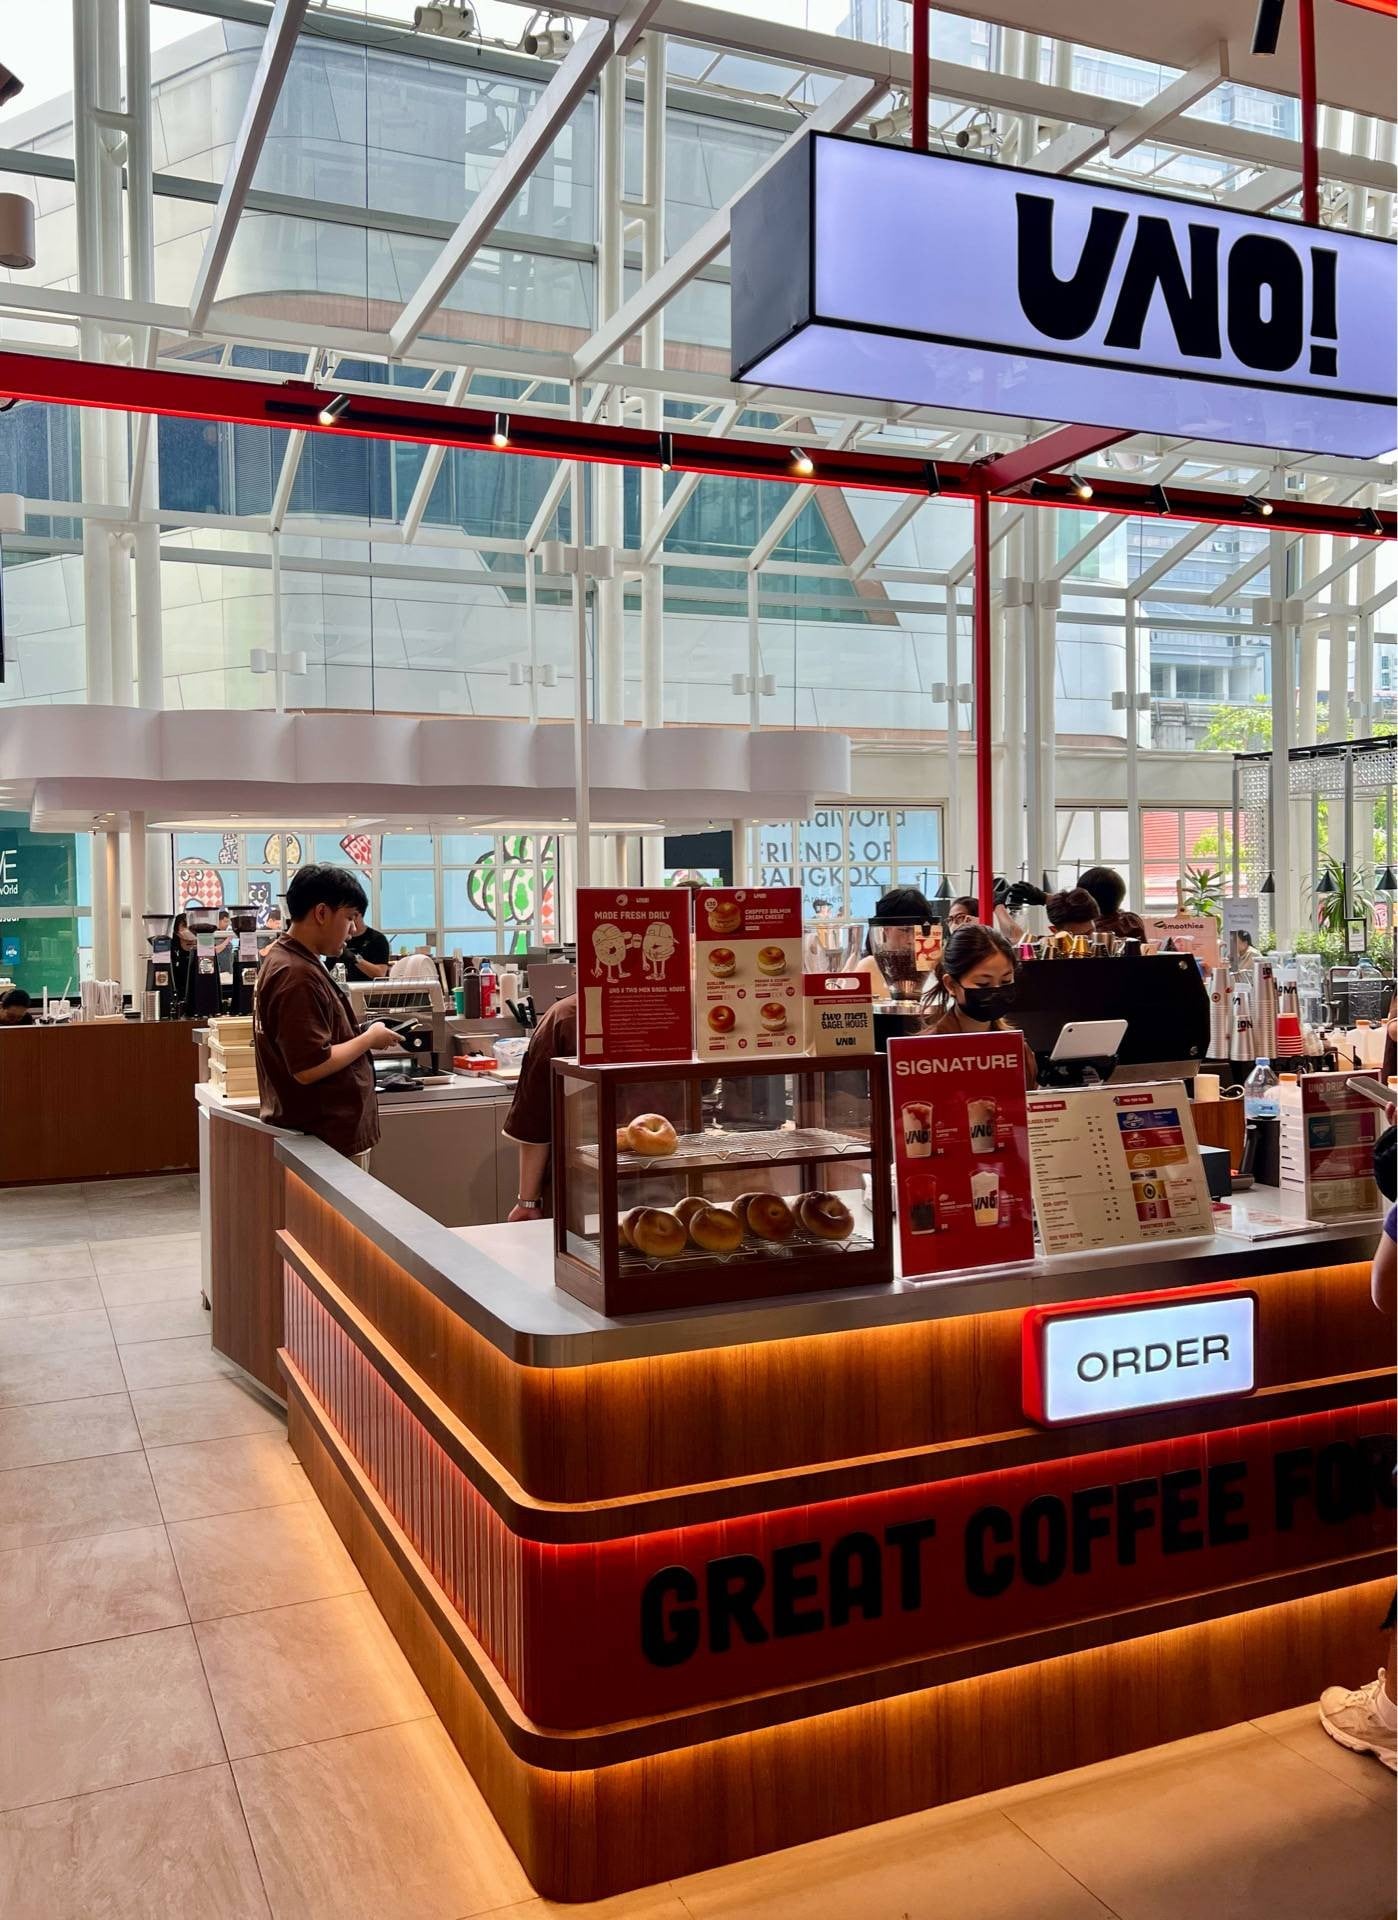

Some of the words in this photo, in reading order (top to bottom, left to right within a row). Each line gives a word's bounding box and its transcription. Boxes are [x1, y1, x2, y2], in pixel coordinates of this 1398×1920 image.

[1015, 192, 1339, 377] UNO!
[594, 911, 618, 920] MADE
[620, 911, 646, 920] FRESH
[648, 911, 671, 920] DAILY
[821, 1011, 841, 1021] two
[844, 1012, 868, 1020] men
[821, 1020, 844, 1029] BAGEL
[845, 1020, 868, 1028] HOUSE
[836, 1037, 856, 1046] UNO!
[896, 1054, 1018, 1076] SIGNATURE
[1077, 1334, 1230, 1382] ORDER
[640, 1519, 936, 1668] GREAT
[964, 1461, 1249, 1598] COFFEE
